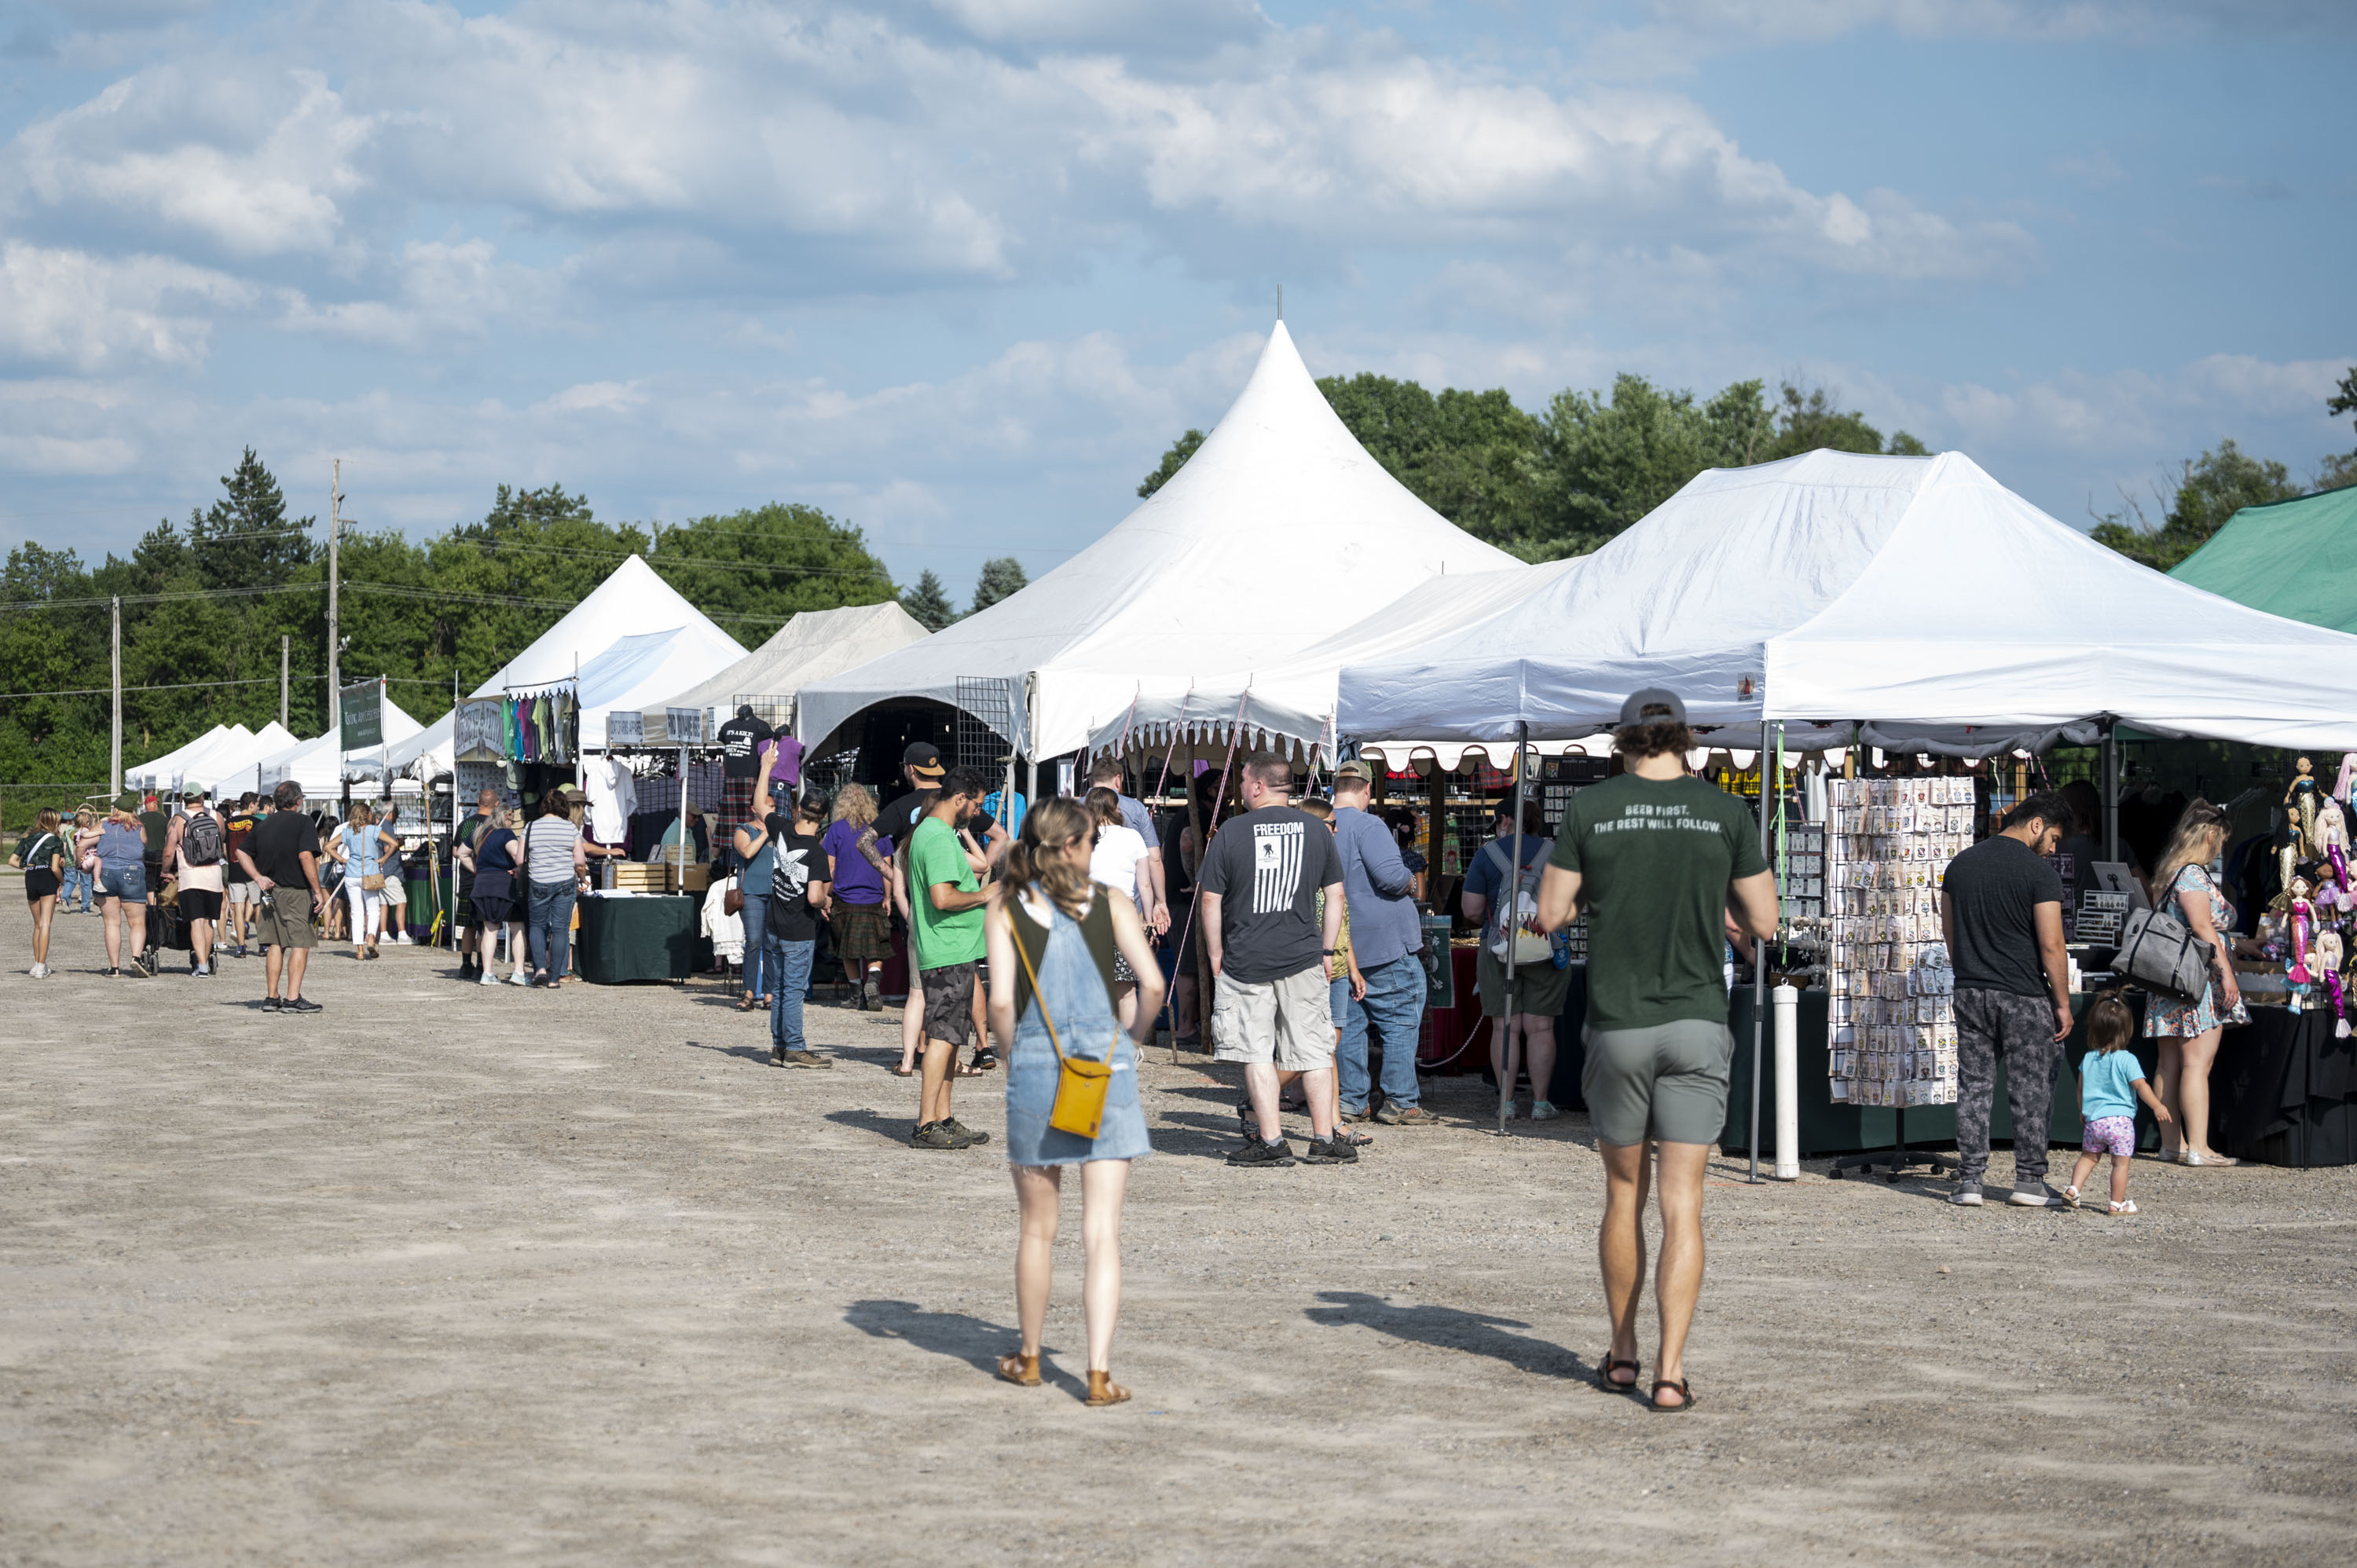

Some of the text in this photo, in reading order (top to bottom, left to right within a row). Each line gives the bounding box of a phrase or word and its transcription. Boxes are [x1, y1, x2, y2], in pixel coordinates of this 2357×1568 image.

[1625, 804, 1690, 816] BEER FIRST.
[1253, 822, 1304, 837] FREEDOM
[1593, 818, 1722, 834] THE REST WILL FOLLOW.
